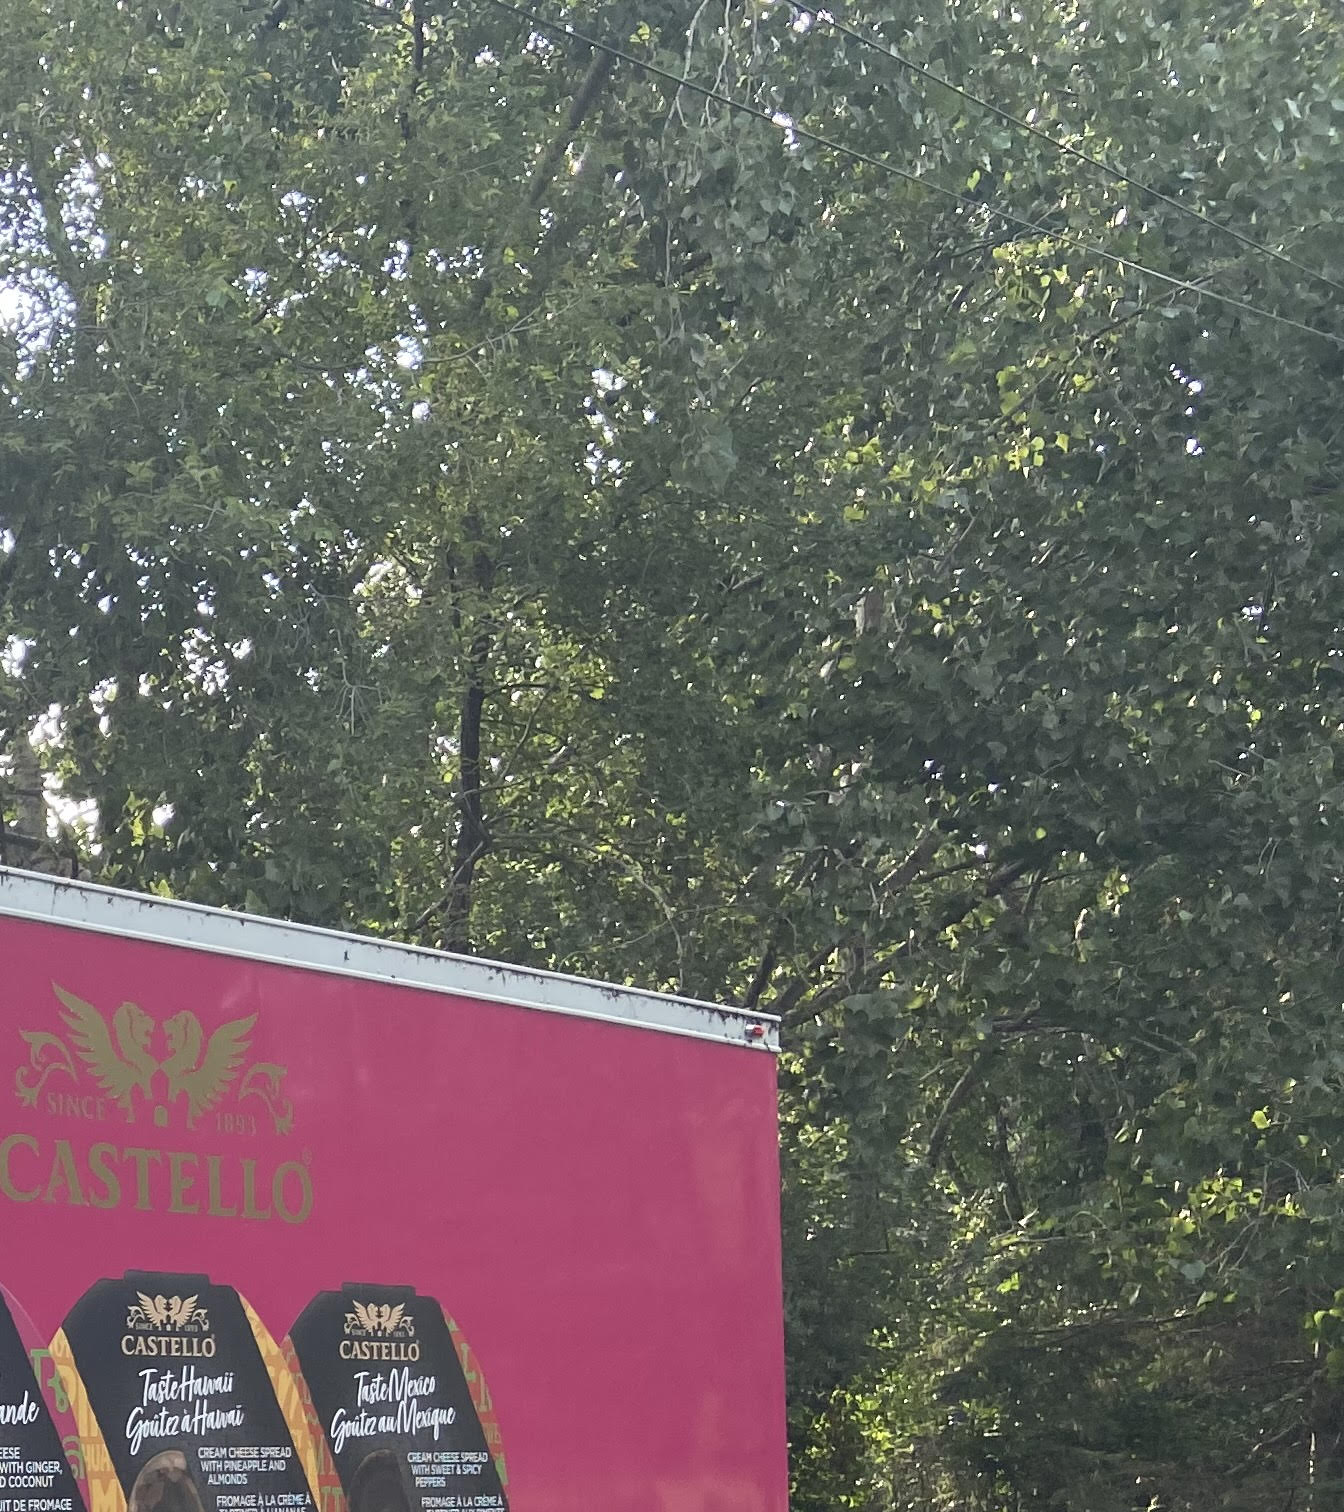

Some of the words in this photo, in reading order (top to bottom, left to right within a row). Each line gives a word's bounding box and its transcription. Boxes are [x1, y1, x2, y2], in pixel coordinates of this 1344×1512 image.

[47, 1092, 106, 1120] SINCE
[215, 1112, 257, 1136] 1893
[121, 1334, 216, 1358] CASTELLO
[339, 1340, 420, 1362] CASTELLO
[138, 1368, 180, 1407] Taste
[177, 1365, 235, 1402] Hawaii
[353, 1371, 390, 1408] Taste
[388, 1366, 436, 1403] Mexico
[125, 1406, 180, 1456] Goûtez
[181, 1408, 193, 1433] à
[190, 1399, 245, 1436] Hawaï
[330, 1408, 377, 1454] Goûtez
[378, 1415, 398, 1433] au
[397, 1398, 456, 1441] Mexique
[198, 1446, 227, 1459] CREAM
[229, 1446, 259, 1458] CHEESE
[260, 1446, 292, 1458] SPREAD
[407, 1451, 433, 1463] CREAM
[433, 1451, 460, 1463] CHEESE
[460, 1451, 489, 1463] SPREAD
[25, 1460, 63, 1475] GINGER,
[200, 1460, 223, 1472] WITH
[223, 1459, 268, 1472] PINEAPPLE
[268, 1459, 286, 1471] AND
[411, 1464, 430, 1475] WITH
[431, 1464, 455, 1475] SWEET
[462, 1464, 483, 1475] SPICY
[8, 1475, 54, 1488] COCONUT
[207, 1473, 248, 1485] ALMONDS
[415, 1476, 446, 1488] PEPPERS
[13, 1499, 27, 1512] DE
[28, 1498, 72, 1511] FROMAGE
[216, 1494, 257, 1507] FROMAGE
[265, 1494, 277, 1506] LA
[463, 1496, 473, 1507] LA
